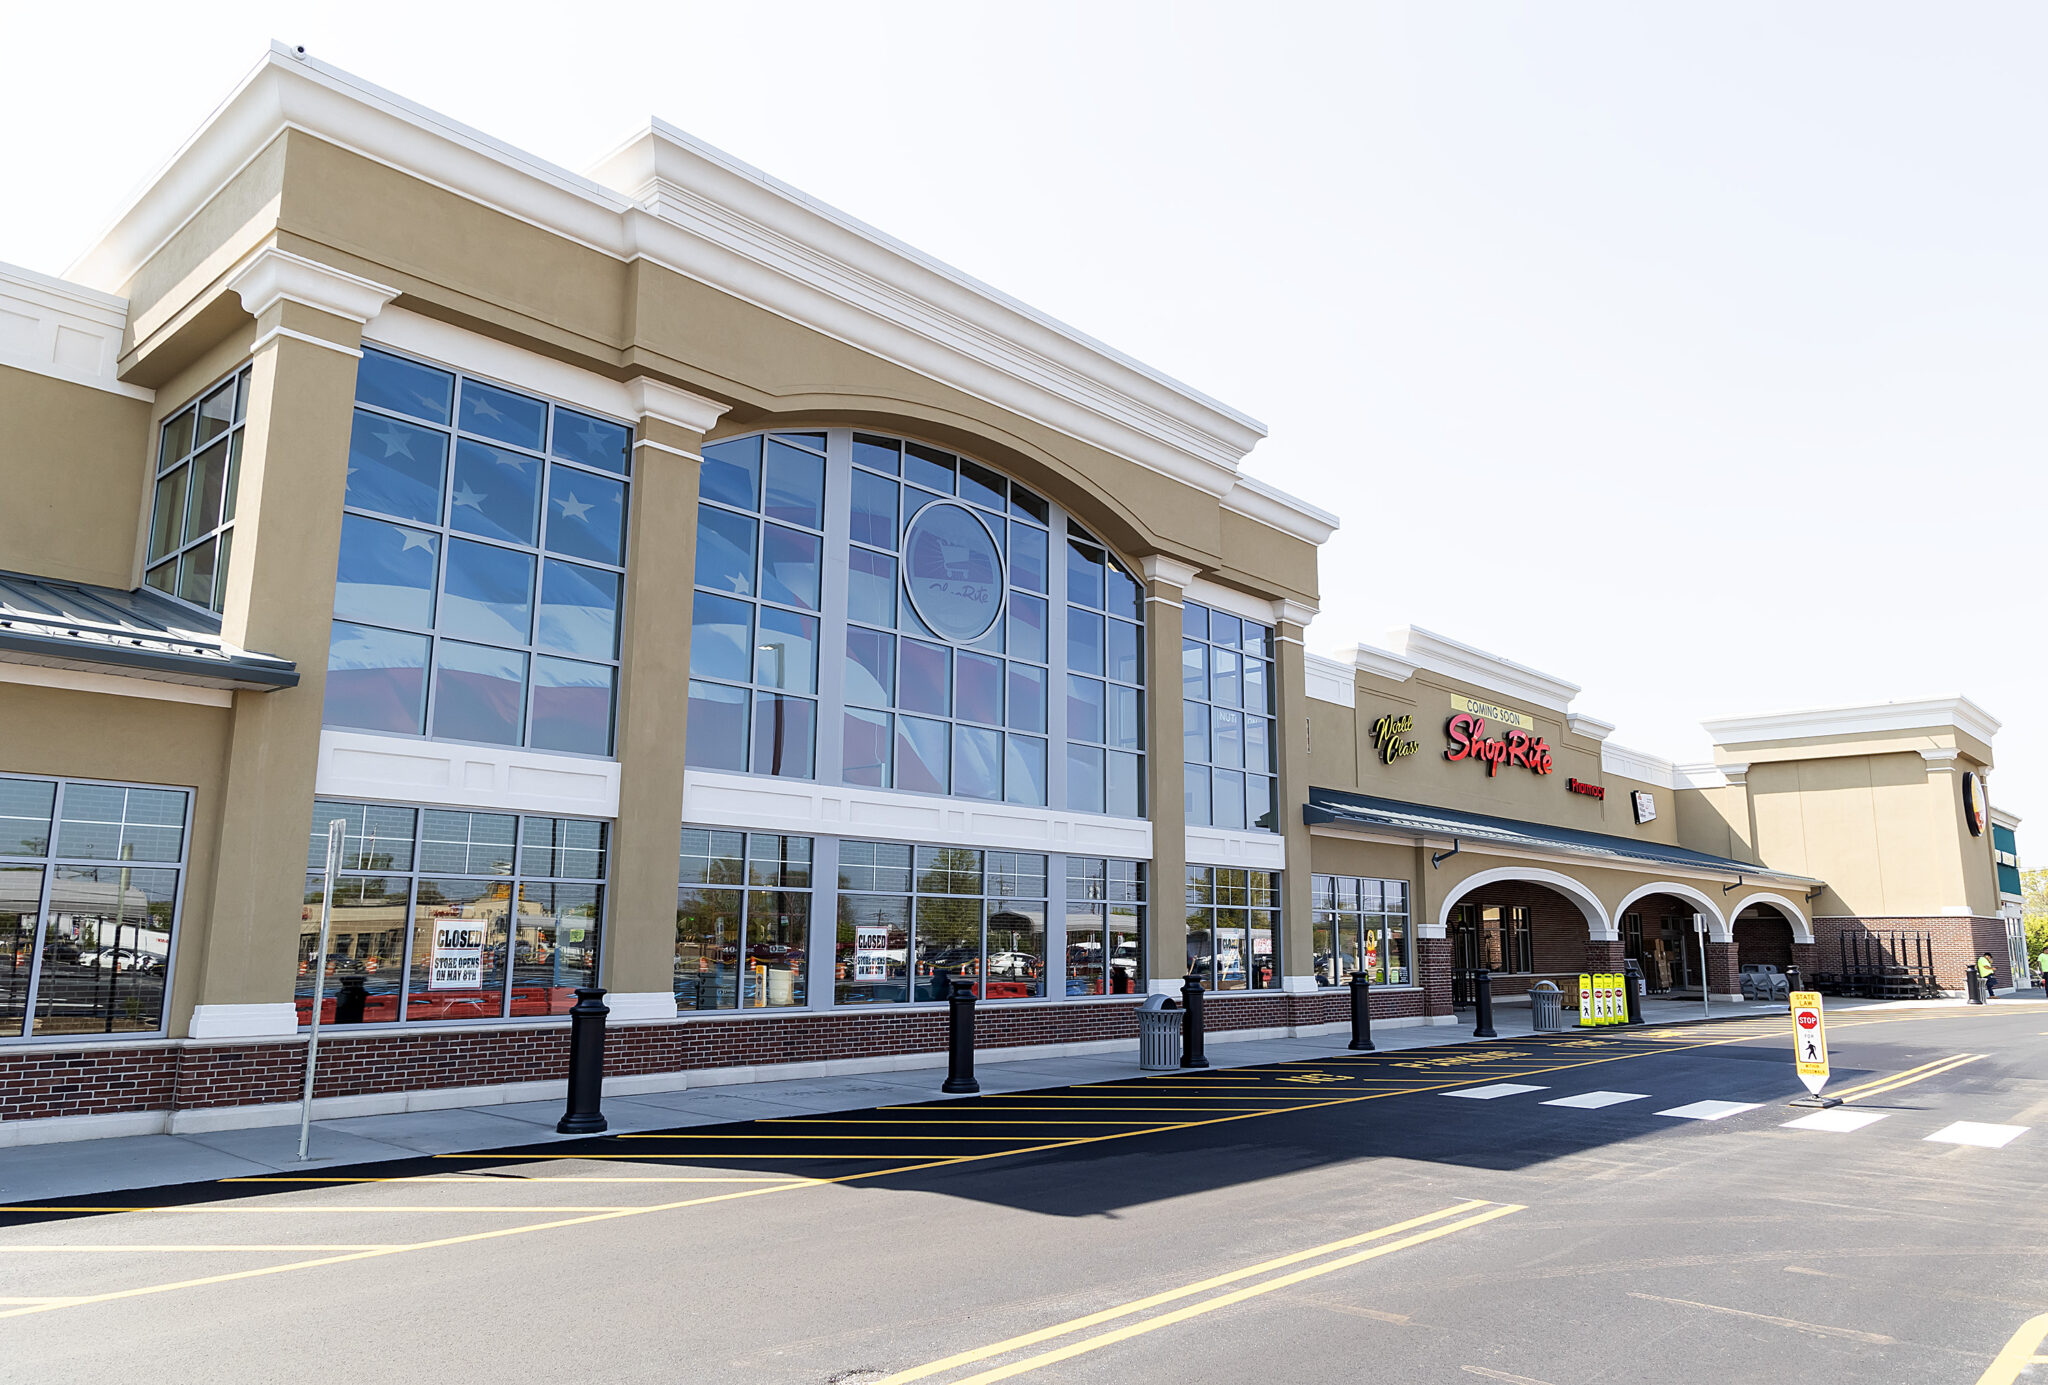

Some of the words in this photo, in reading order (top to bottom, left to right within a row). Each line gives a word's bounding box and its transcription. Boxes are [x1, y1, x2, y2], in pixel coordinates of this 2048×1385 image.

[1467, 700, 1498, 719] COMING
[1500, 709, 1520, 725] SOON
[1374, 714, 1414, 749] World
[1385, 735, 1419, 765] Class
[1447, 713, 1552, 777] ShopRite
[1571, 778, 1605, 800] Pharmacy
[437, 929, 482, 947] CLOSED
[858, 935, 885, 948] CLOSED
[435, 957, 457, 968] STORE
[459, 957, 479, 968] OPENS
[436, 970, 446, 980] ON
[447, 970, 462, 980] MAY
[463, 970, 477, 980] 8TH
[1798, 1016, 1817, 1024] STOP
